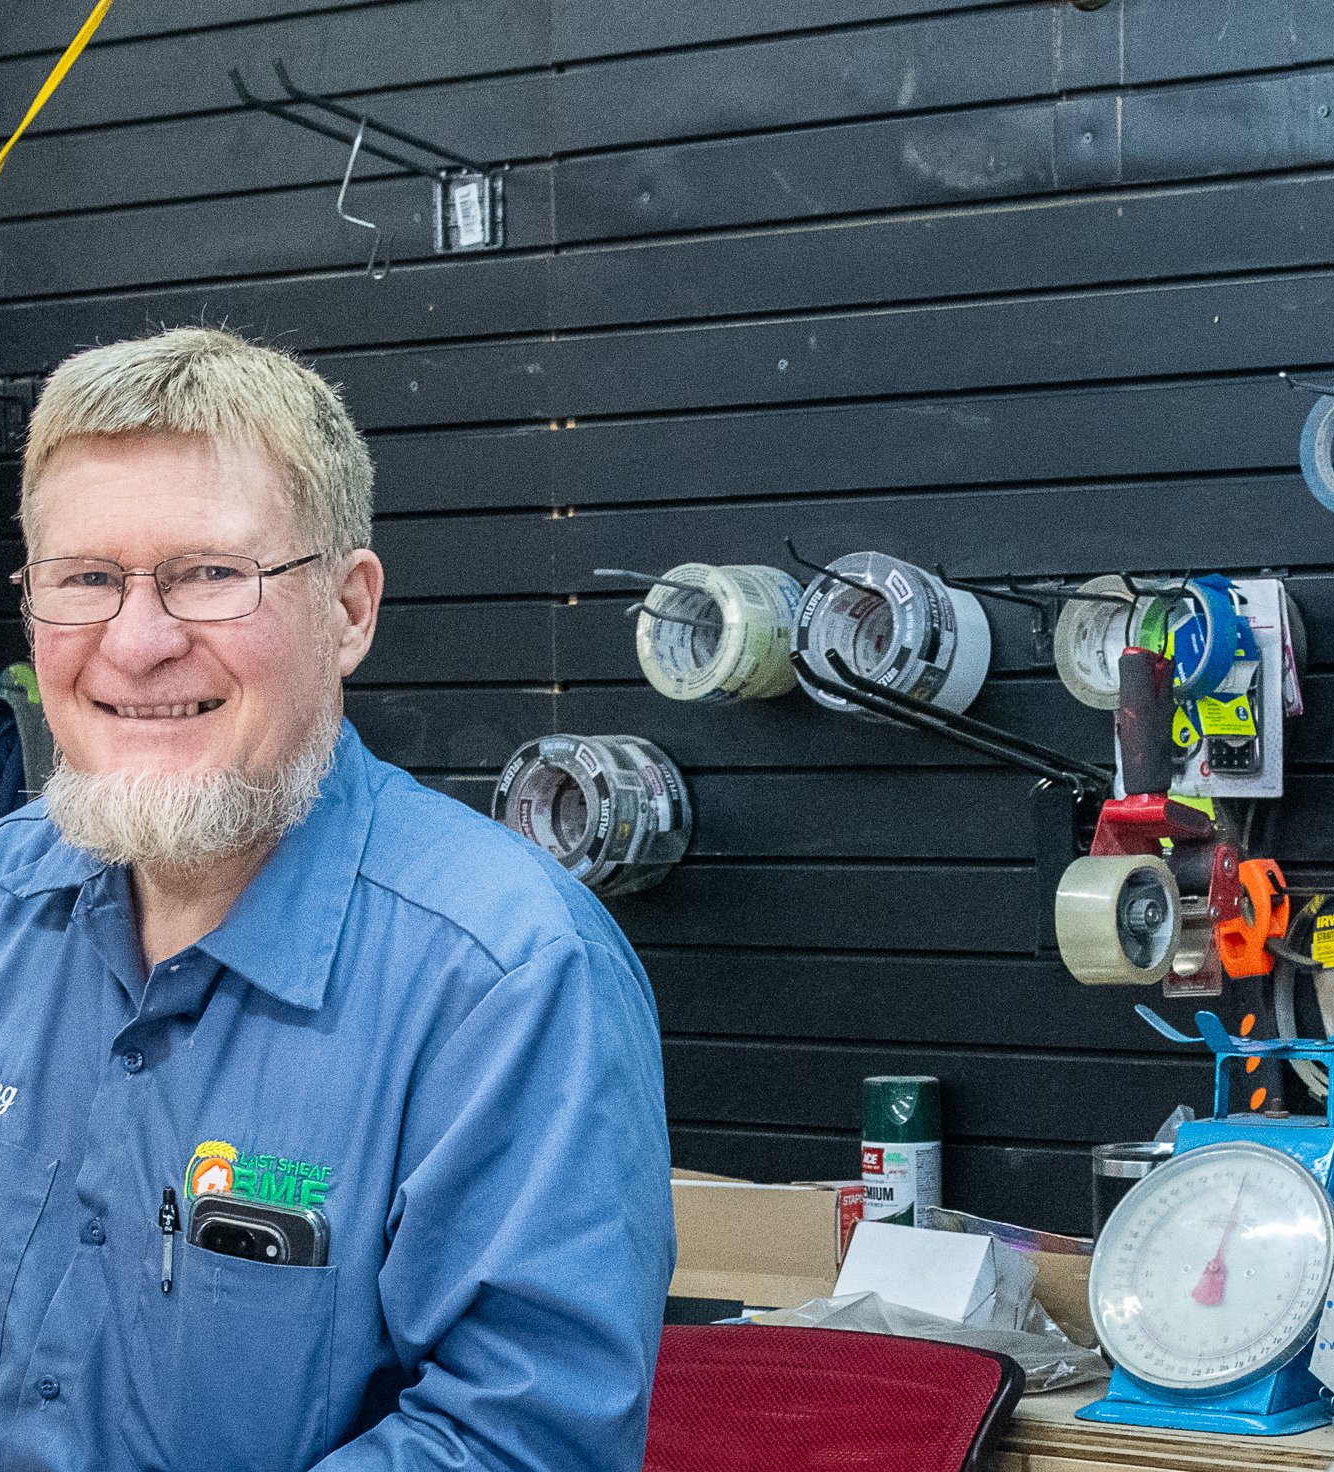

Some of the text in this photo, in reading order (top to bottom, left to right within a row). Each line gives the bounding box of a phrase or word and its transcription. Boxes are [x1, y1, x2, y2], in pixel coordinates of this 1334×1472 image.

[238, 1153, 333, 1179] LAST SHEAF
[863, 1151, 879, 1165] ACE
[233, 1165, 330, 1206] BME
